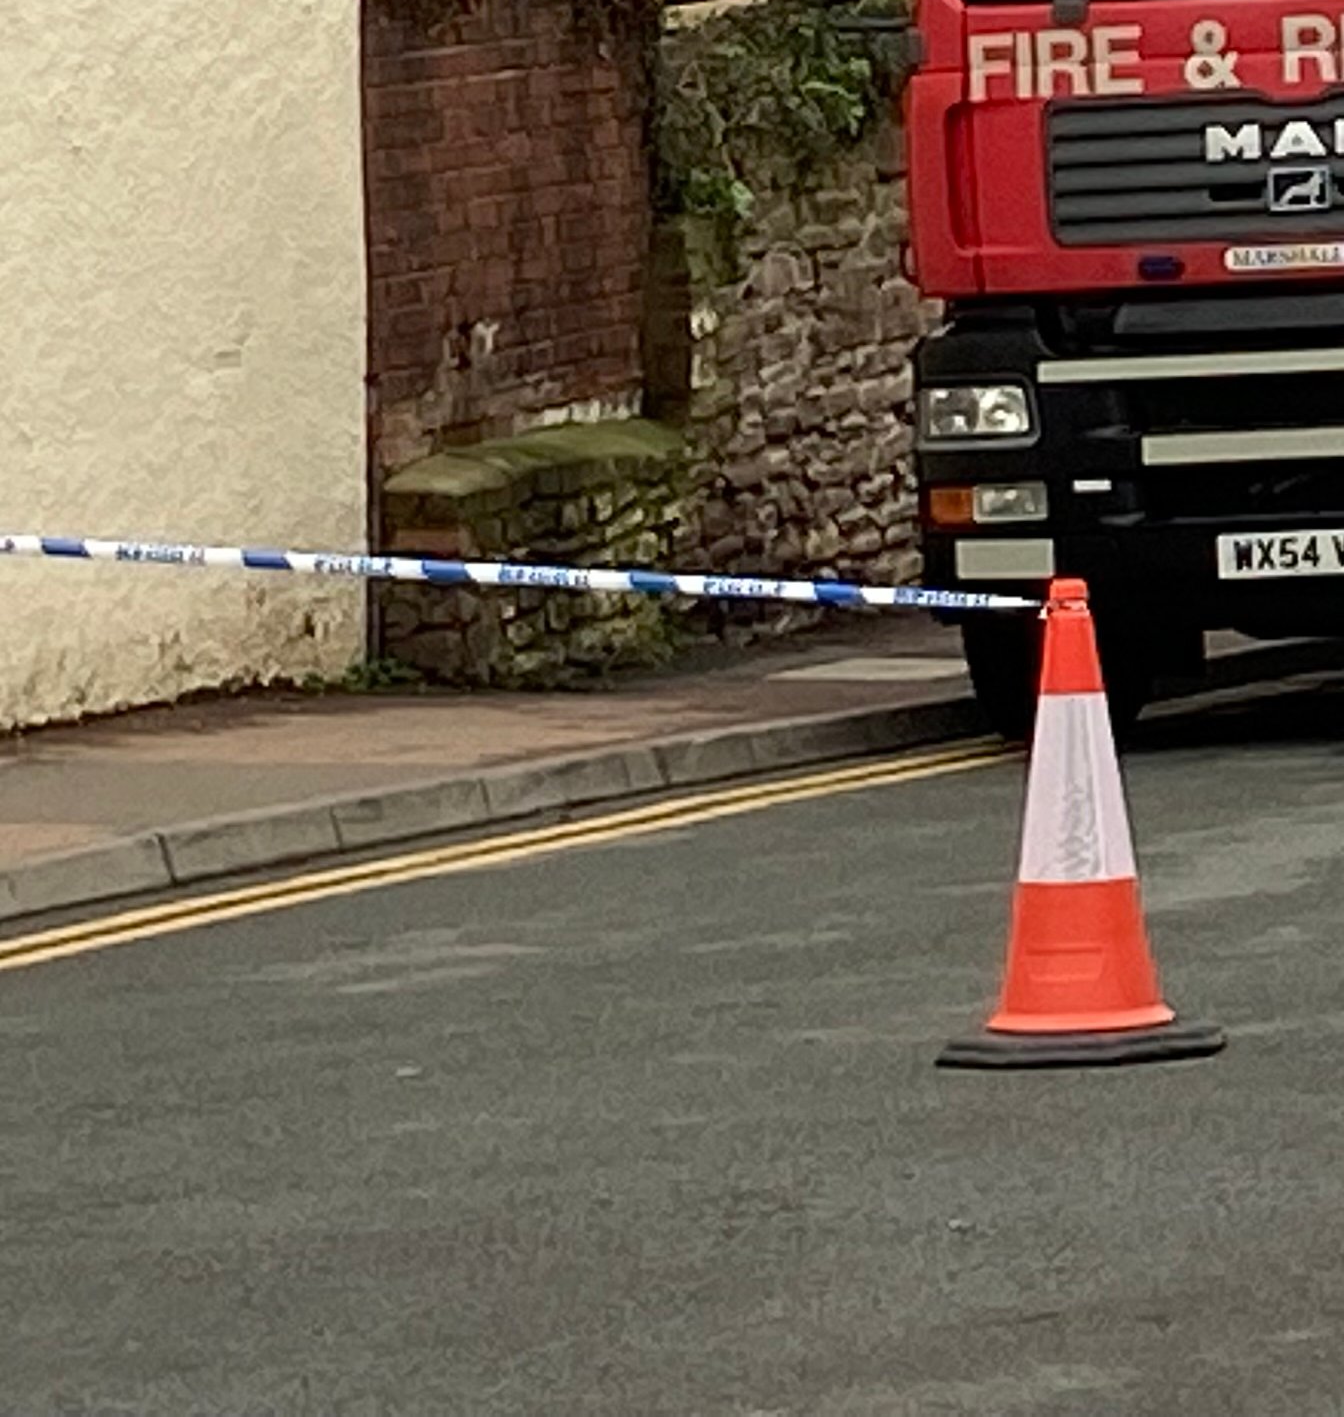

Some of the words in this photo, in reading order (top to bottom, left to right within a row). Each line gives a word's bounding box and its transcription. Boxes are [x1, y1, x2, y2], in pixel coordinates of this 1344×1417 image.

[967, 24, 1143, 102] FIRE
[1183, 19, 1242, 89] &
[1234, 534, 1322, 571] WX54
